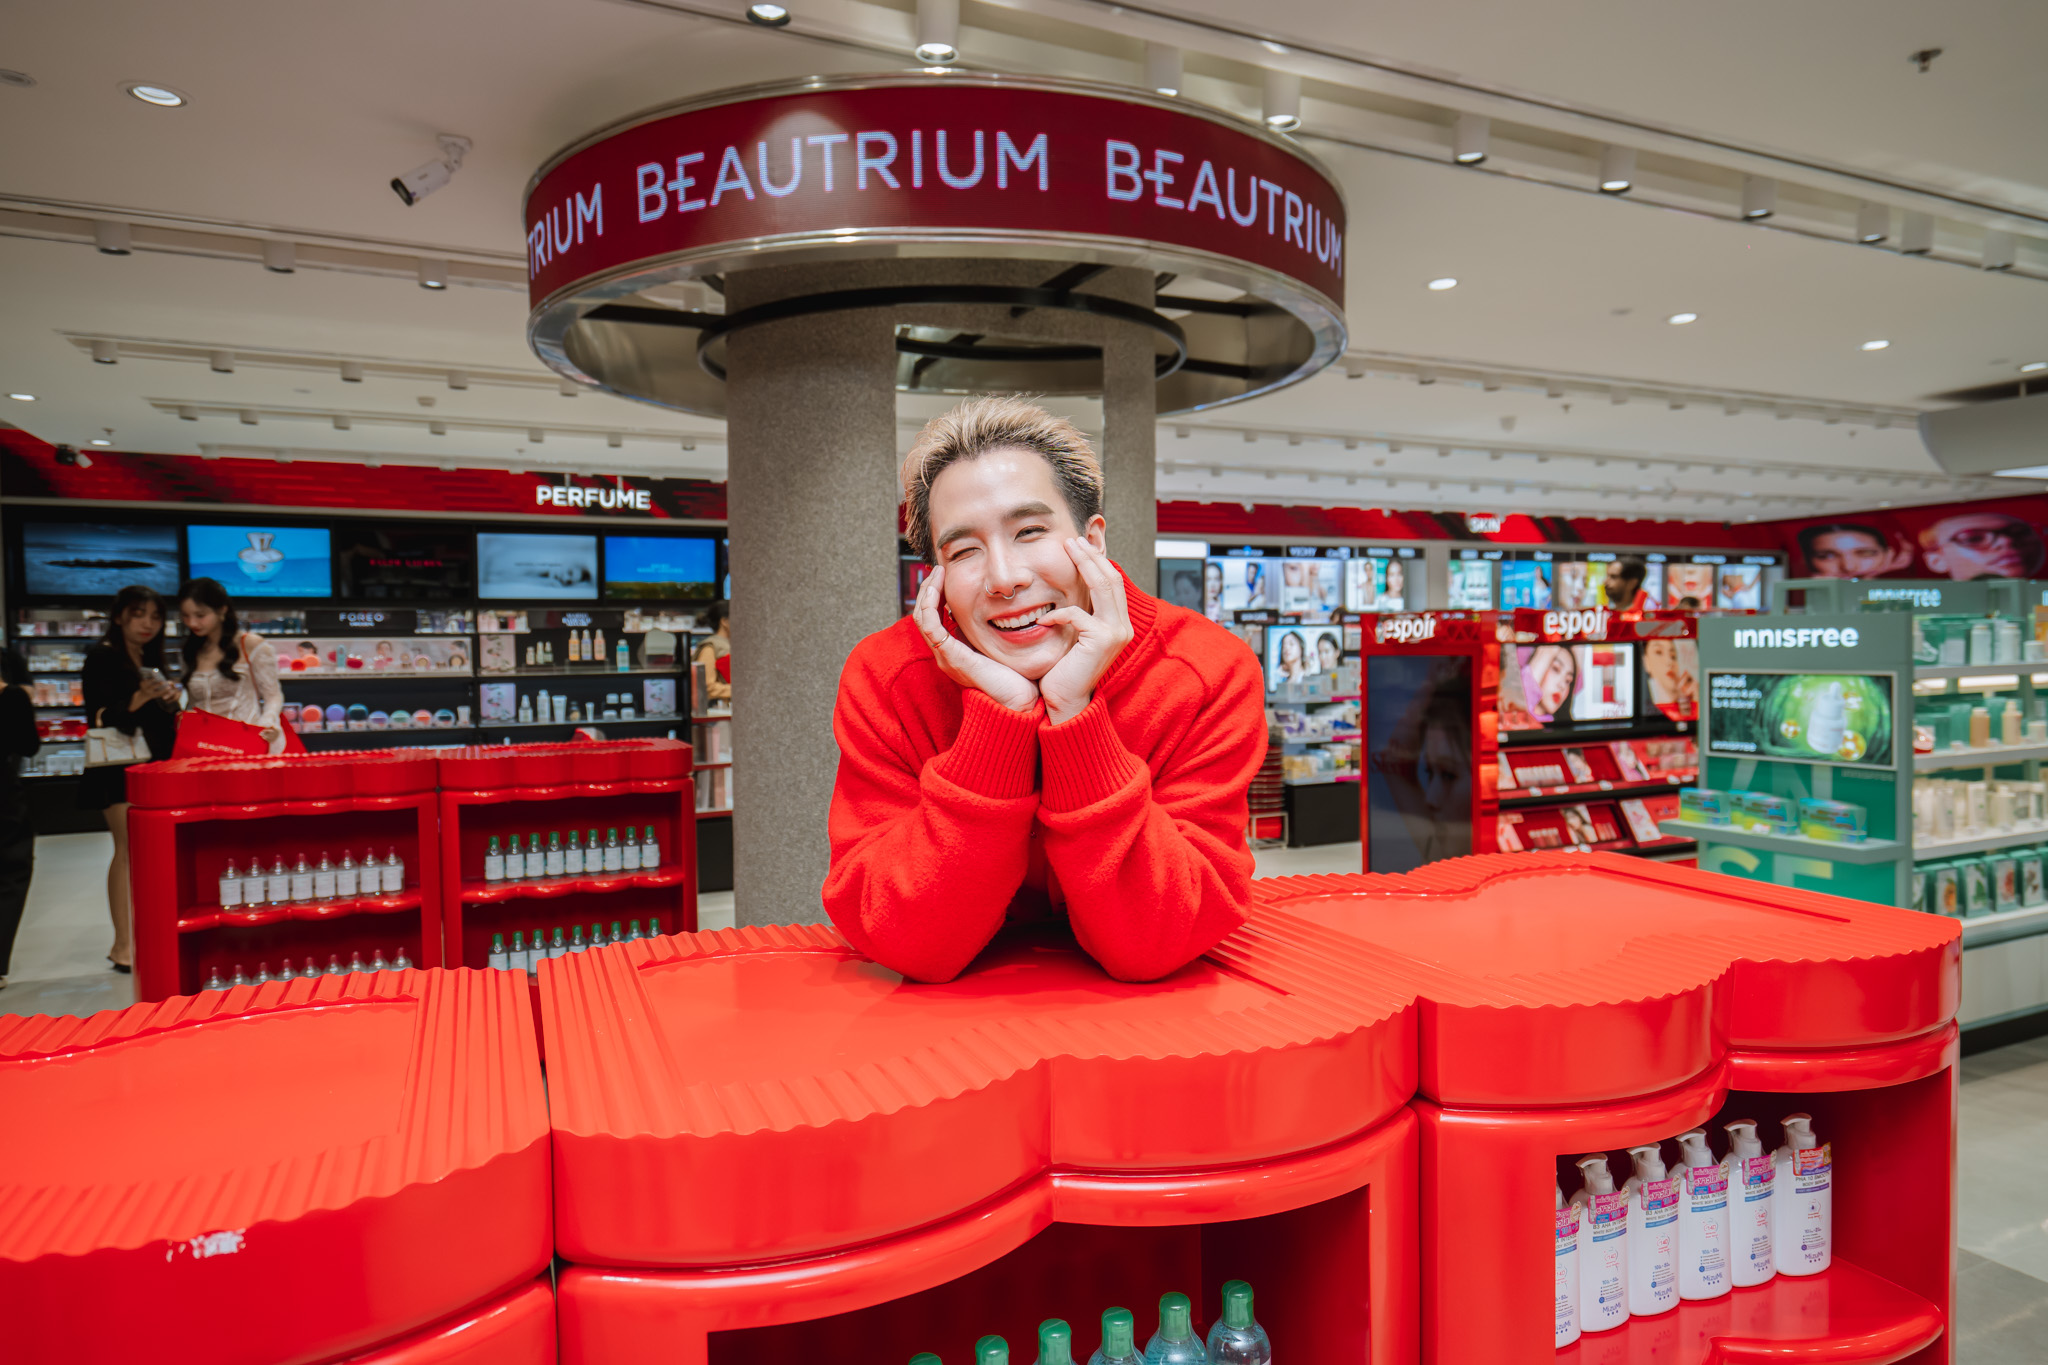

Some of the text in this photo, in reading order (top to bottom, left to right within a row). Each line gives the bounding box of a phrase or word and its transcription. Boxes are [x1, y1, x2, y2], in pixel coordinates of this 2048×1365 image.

[636, 129, 1049, 223] BEAUTRIUM
[1105, 138, 1342, 278] BEAUTRIUM
[528, 182, 603, 280] TRIUM
[536, 484, 652, 510] PERFUME
[338, 611, 385, 623] FOREO
[1702, 1272, 1723, 1282] MizuMi
[1654, 1287, 1673, 1297] MizuMi
[1602, 1302, 1622, 1313] MizuMi
[1556, 1320, 1572, 1331] izuMi
